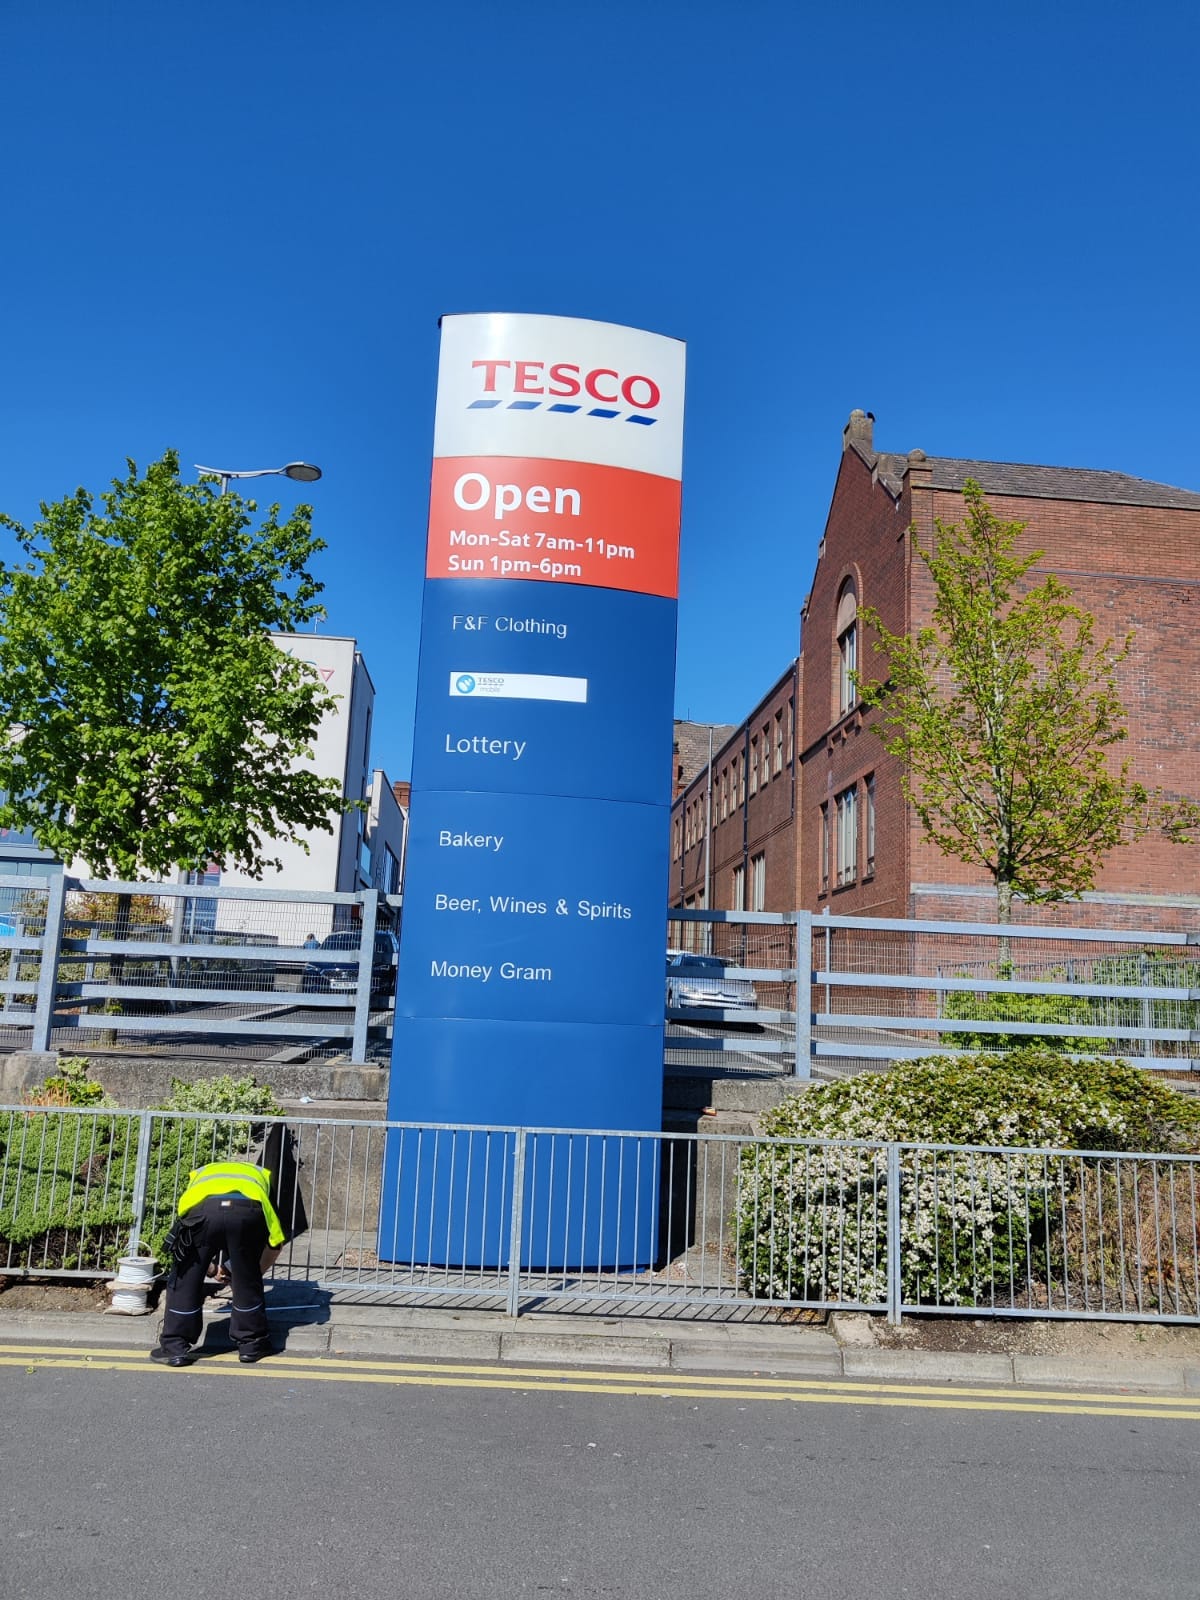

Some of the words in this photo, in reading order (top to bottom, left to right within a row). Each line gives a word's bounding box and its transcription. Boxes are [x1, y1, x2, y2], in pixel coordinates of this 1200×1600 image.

[471, 360, 661, 409] TESCO
[453, 472, 581, 519] Open
[449, 530, 530, 547] Mon-Sat
[534, 532, 635, 559] 7am-11pm
[448, 555, 484, 571] Sun
[490, 556, 582, 577] 1pm-6pm
[452, 615, 489, 631] F&F
[495, 617, 568, 639] Clothing
[445, 734, 526, 760] Lottery
[439, 831, 504, 852] Bakery
[435, 894, 482, 914] Beer,
[489, 896, 547, 914] Wines
[555, 898, 569, 916] &
[577, 900, 632, 921] Spirits
[430, 961, 493, 983] Money
[500, 962, 552, 981] Gram
